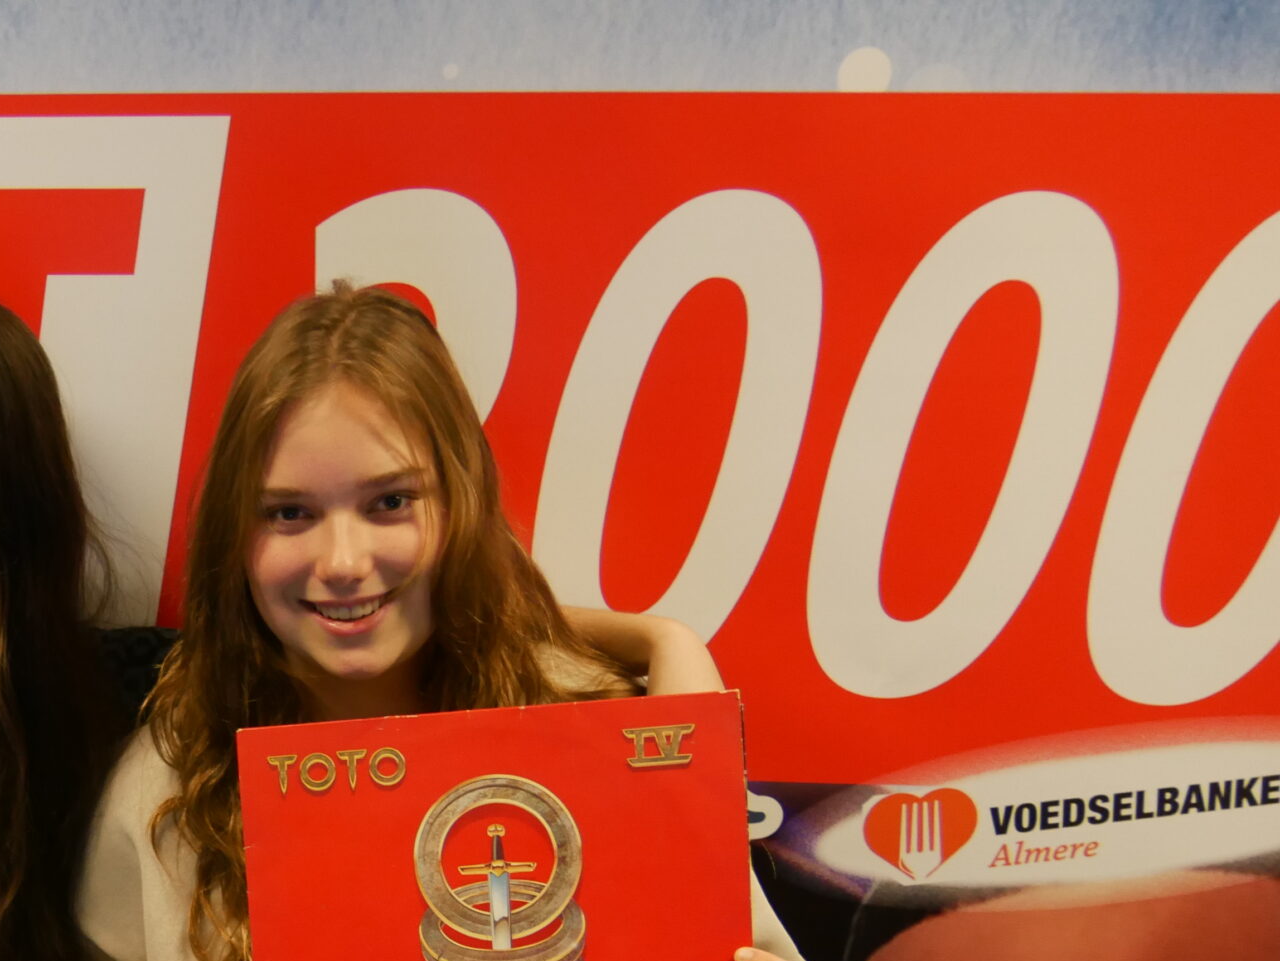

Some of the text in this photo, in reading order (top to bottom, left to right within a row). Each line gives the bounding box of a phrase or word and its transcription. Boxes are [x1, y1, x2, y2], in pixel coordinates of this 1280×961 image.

[267, 723, 695, 795] TOTO IV
[989, 774, 1280, 836] VOEDSELBANKE
[988, 839, 1100, 869] Almere
